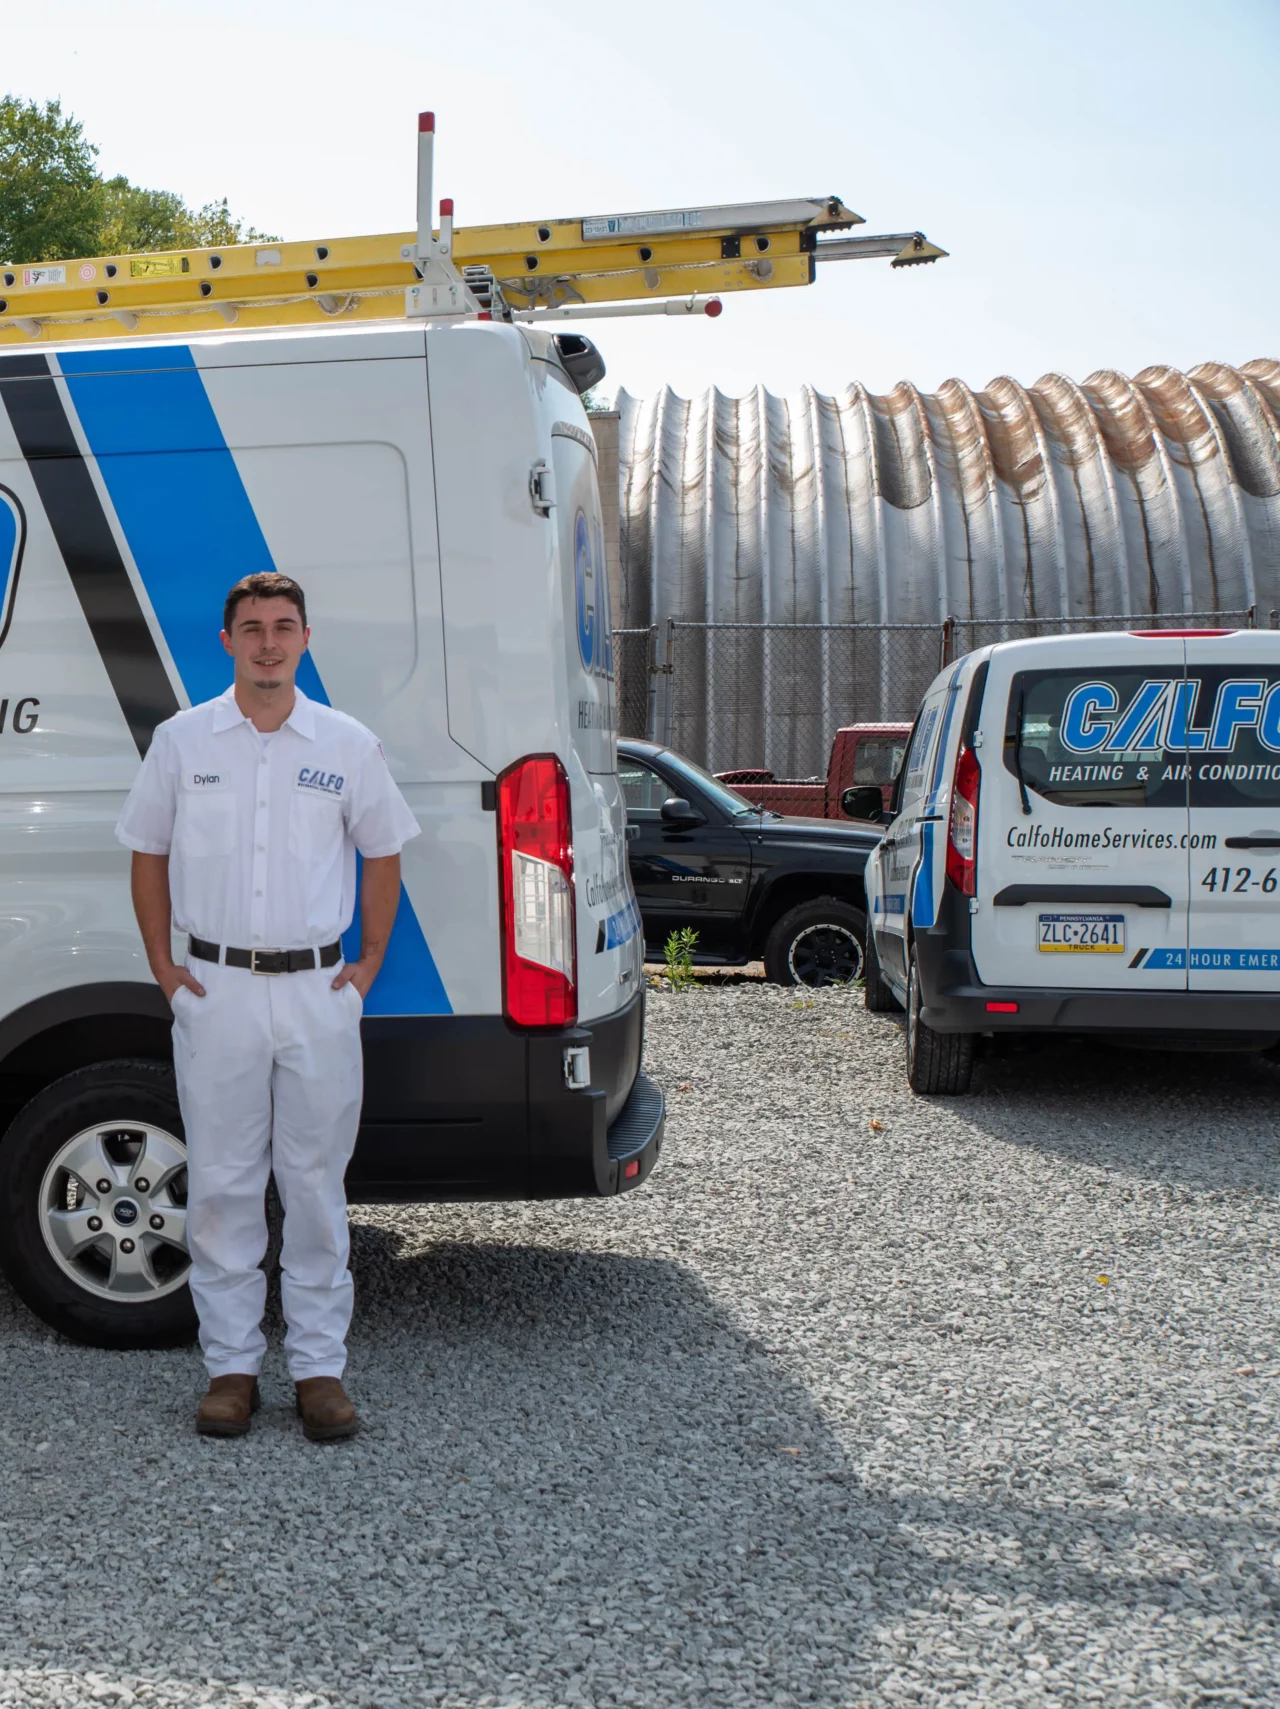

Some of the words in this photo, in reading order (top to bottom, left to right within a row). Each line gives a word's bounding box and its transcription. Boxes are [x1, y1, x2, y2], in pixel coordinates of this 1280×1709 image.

[193, 774, 220, 785] Dylan
[298, 768, 344, 790] CALFO
[1049, 765, 1124, 781] HEATING
[1136, 766, 1149, 780] &
[1161, 764, 1192, 780] AIR
[1007, 825, 1217, 849] CalfoHomeServices.com
[672, 875, 726, 883] DURANGO
[1201, 867, 1278, 893] 412-6
[1165, 953, 1182, 965] 24
[1190, 953, 1231, 966] HOUR
[1239, 954, 1278, 967] EMER
